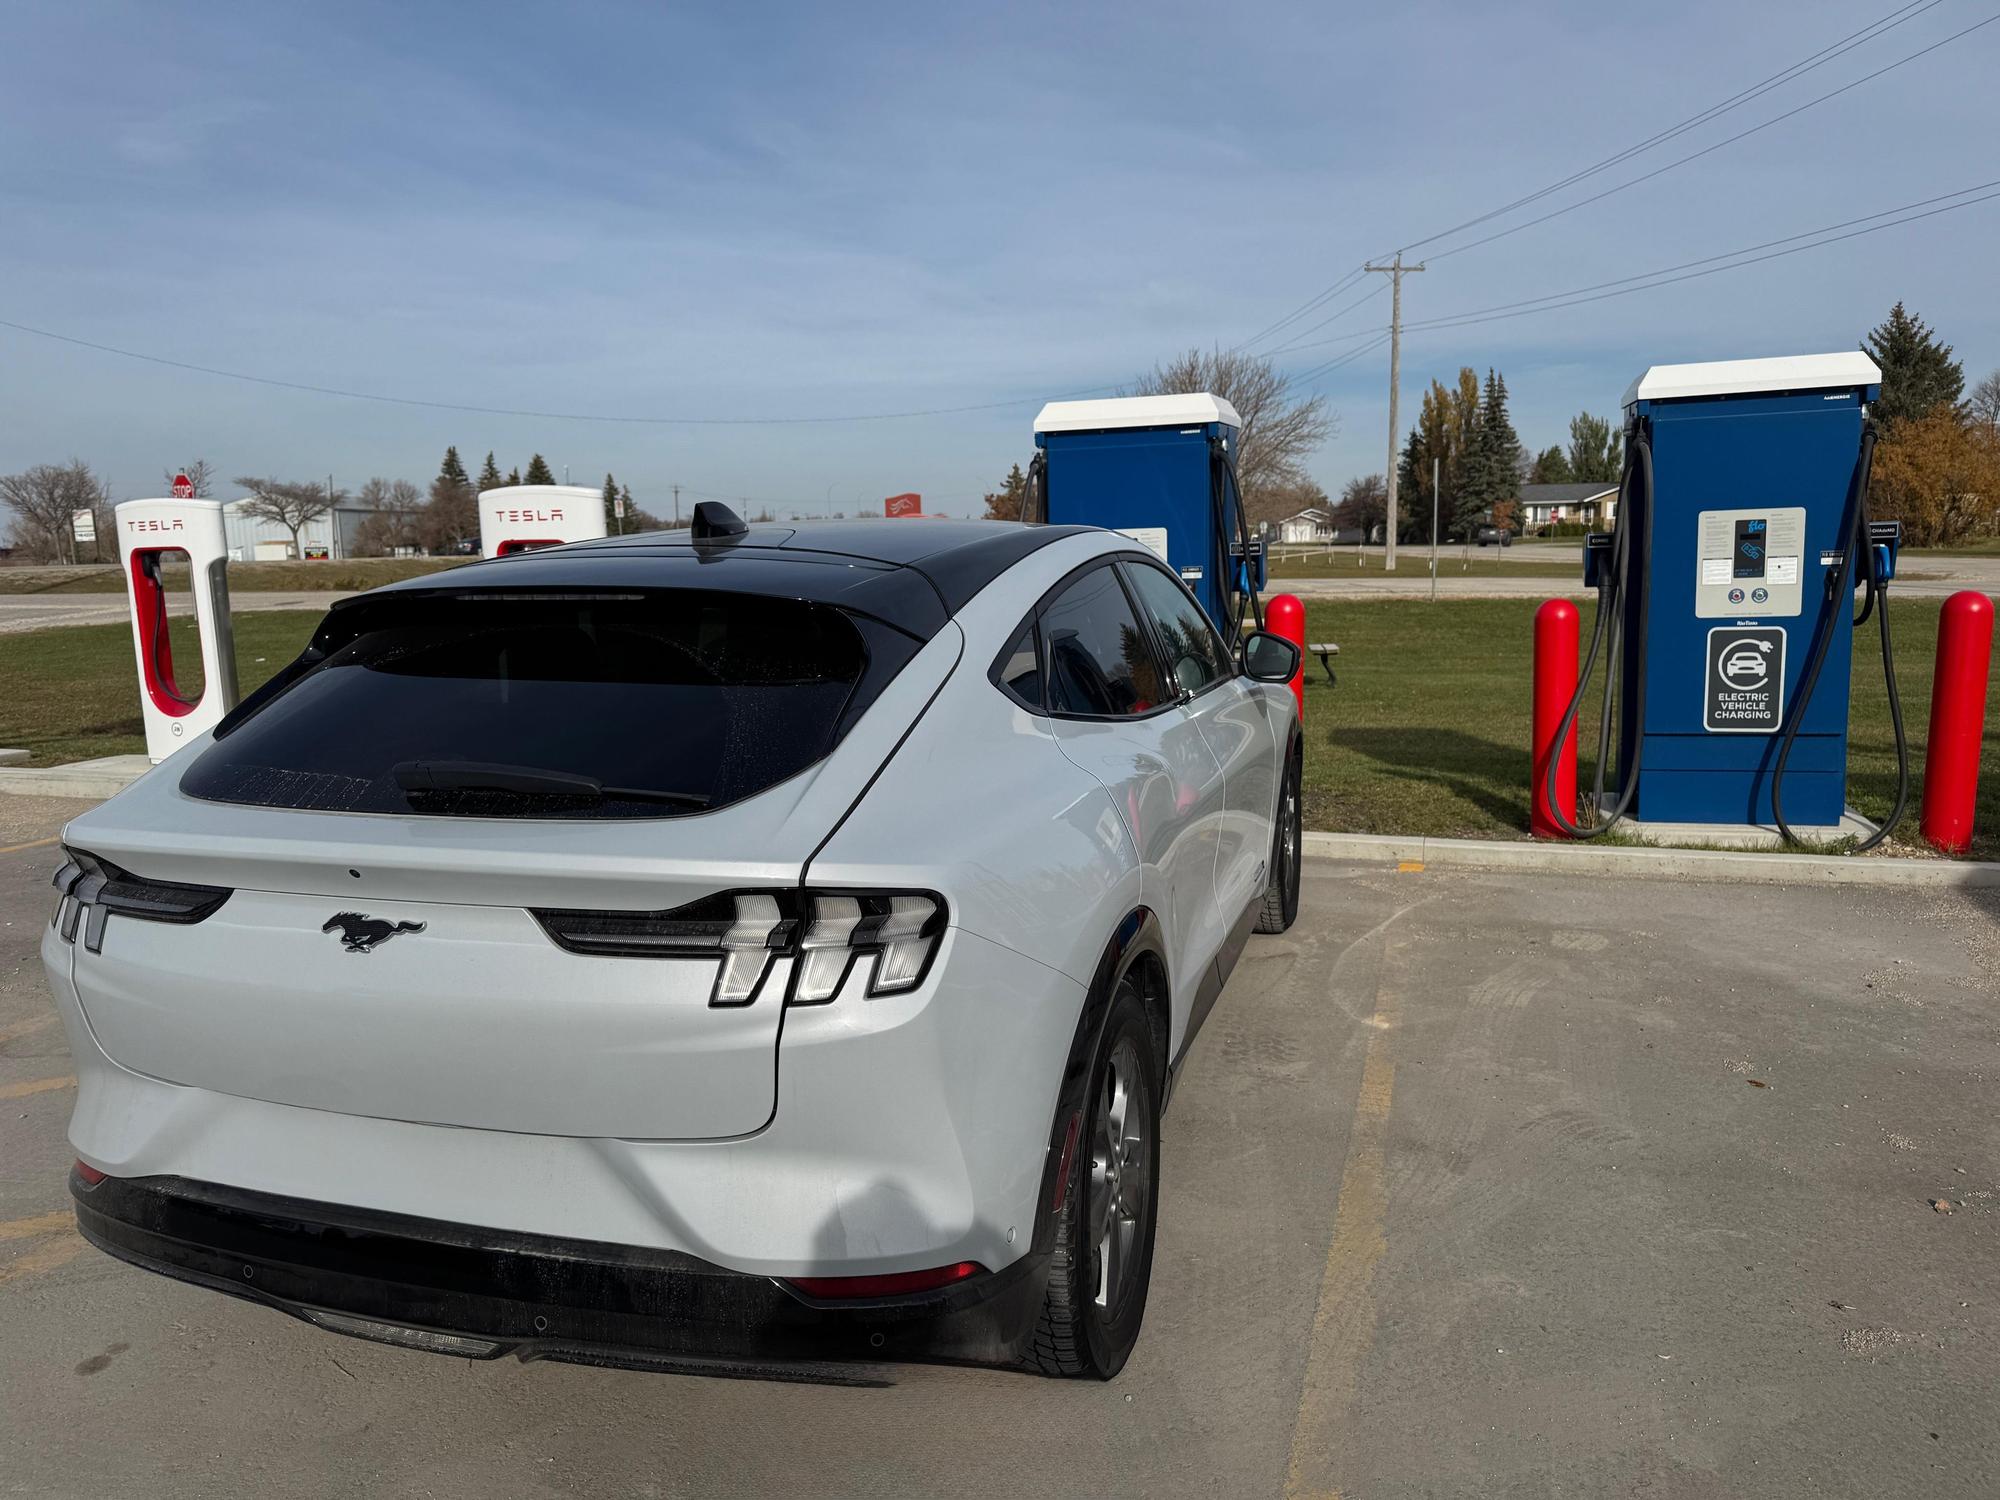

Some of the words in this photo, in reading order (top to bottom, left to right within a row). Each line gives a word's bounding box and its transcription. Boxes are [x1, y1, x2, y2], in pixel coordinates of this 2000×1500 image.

[173, 485, 191, 498] STOP
[496, 509, 563, 522] TESLA
[128, 519, 183, 532] TESLA
[1748, 521, 1765, 533] flo
[1718, 692, 1769, 701] ELECTRIC
[1721, 702, 1766, 710] VEHICLE
[1715, 711, 1771, 719] CHARGING
